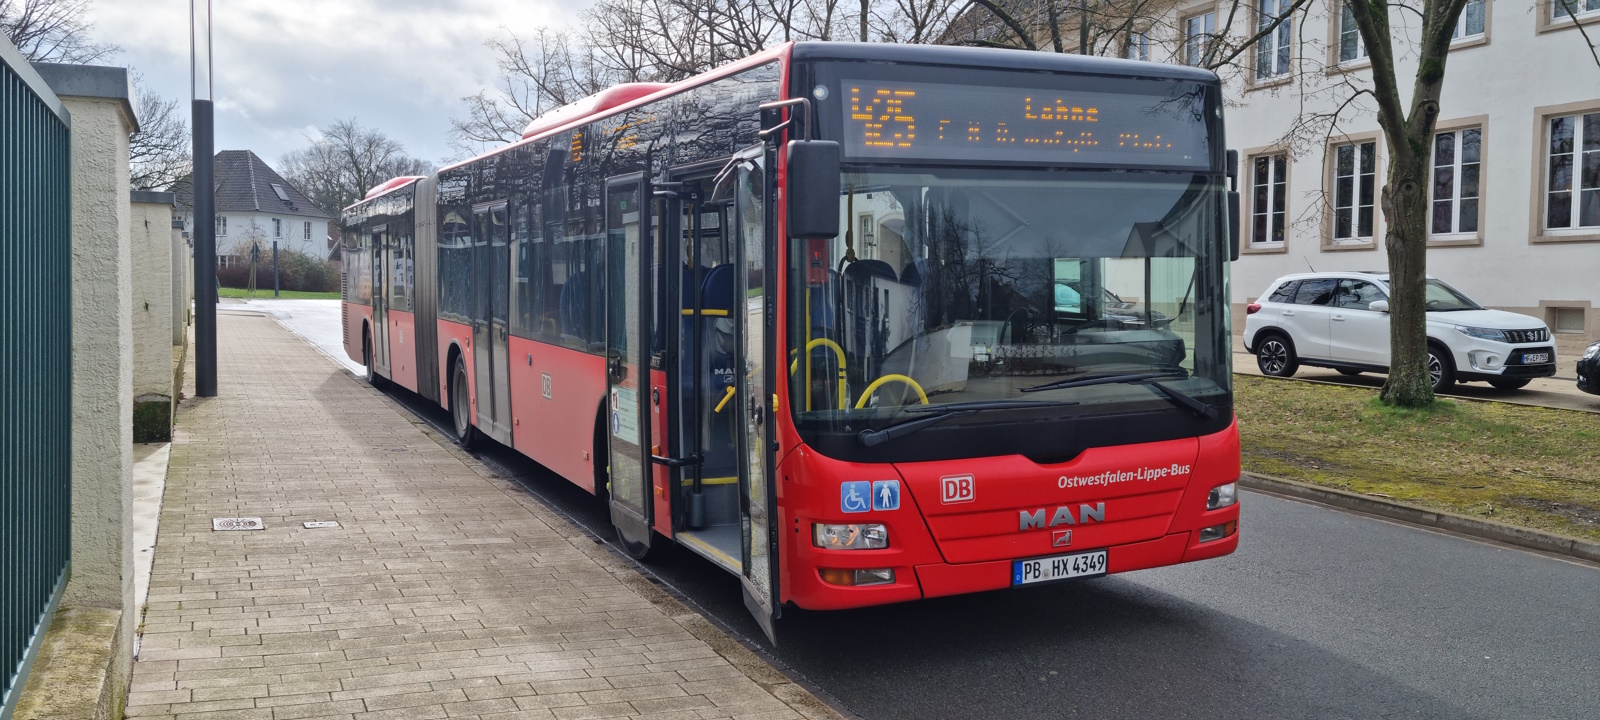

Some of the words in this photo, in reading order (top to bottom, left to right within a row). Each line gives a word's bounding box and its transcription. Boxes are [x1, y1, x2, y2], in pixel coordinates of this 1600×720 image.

[542, 375, 551, 397] DB
[944, 477, 973, 501] DB
[1057, 463, 1191, 489] Ostwestfalen-Lippe-Bus
[1019, 502, 1106, 531] MAN
[1024, 561, 1041, 580] PB
[1052, 558, 1069, 577] HX
[1073, 553, 1105, 574] 4349
